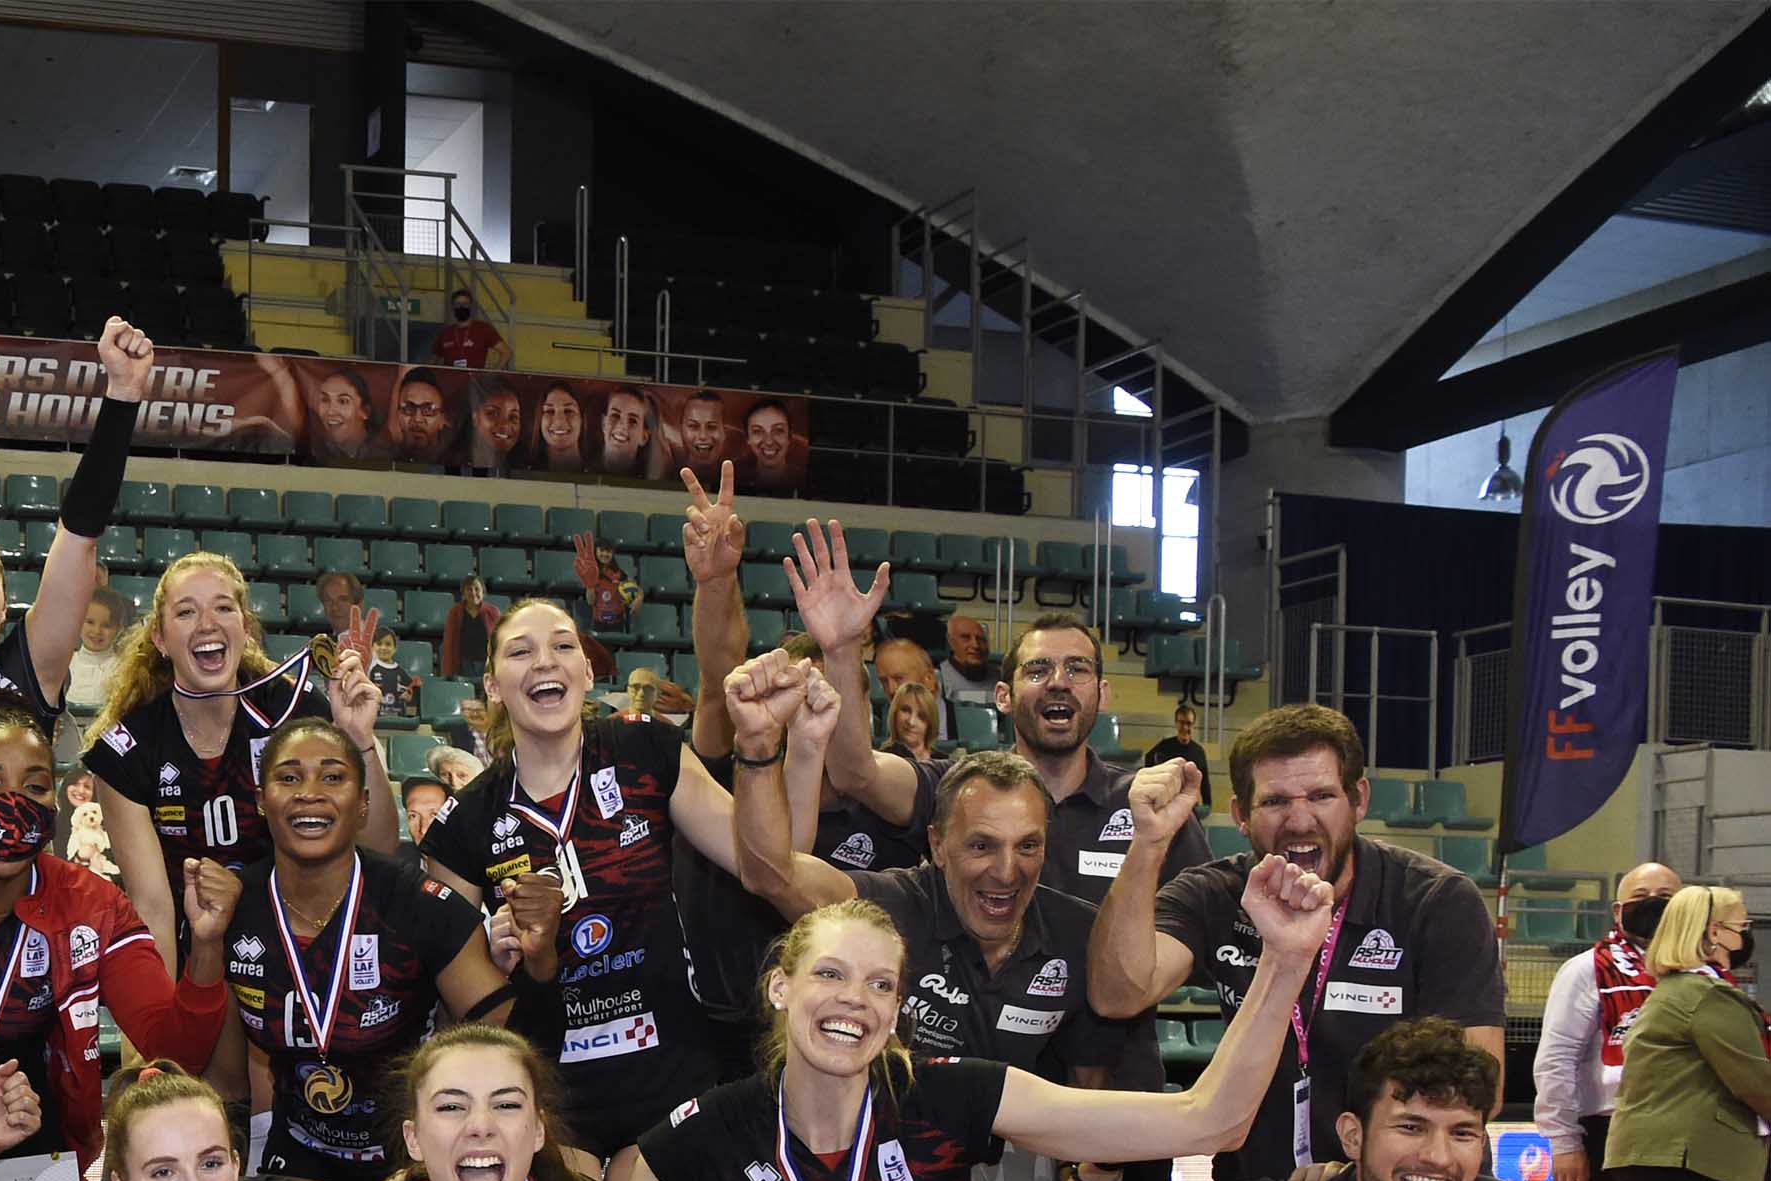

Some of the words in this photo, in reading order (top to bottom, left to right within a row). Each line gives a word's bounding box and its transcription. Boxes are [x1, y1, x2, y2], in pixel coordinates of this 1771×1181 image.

[66, 360, 220, 401] D'TRE
[203, 795, 238, 847] 10
[1083, 860, 1120, 869] VINC
[27, 951, 44, 961] LAF
[230, 961, 264, 977] errea
[354, 962, 374, 972] LAF
[355, 978, 374, 986] VOLLEY
[566, 989, 641, 1018] Mulhouse
[1329, 992, 1373, 1003] VINCI
[614, 1003, 643, 1016] SPORT
[1005, 1014, 1043, 1026] VINCI
[564, 1033, 618, 1053] INCI
